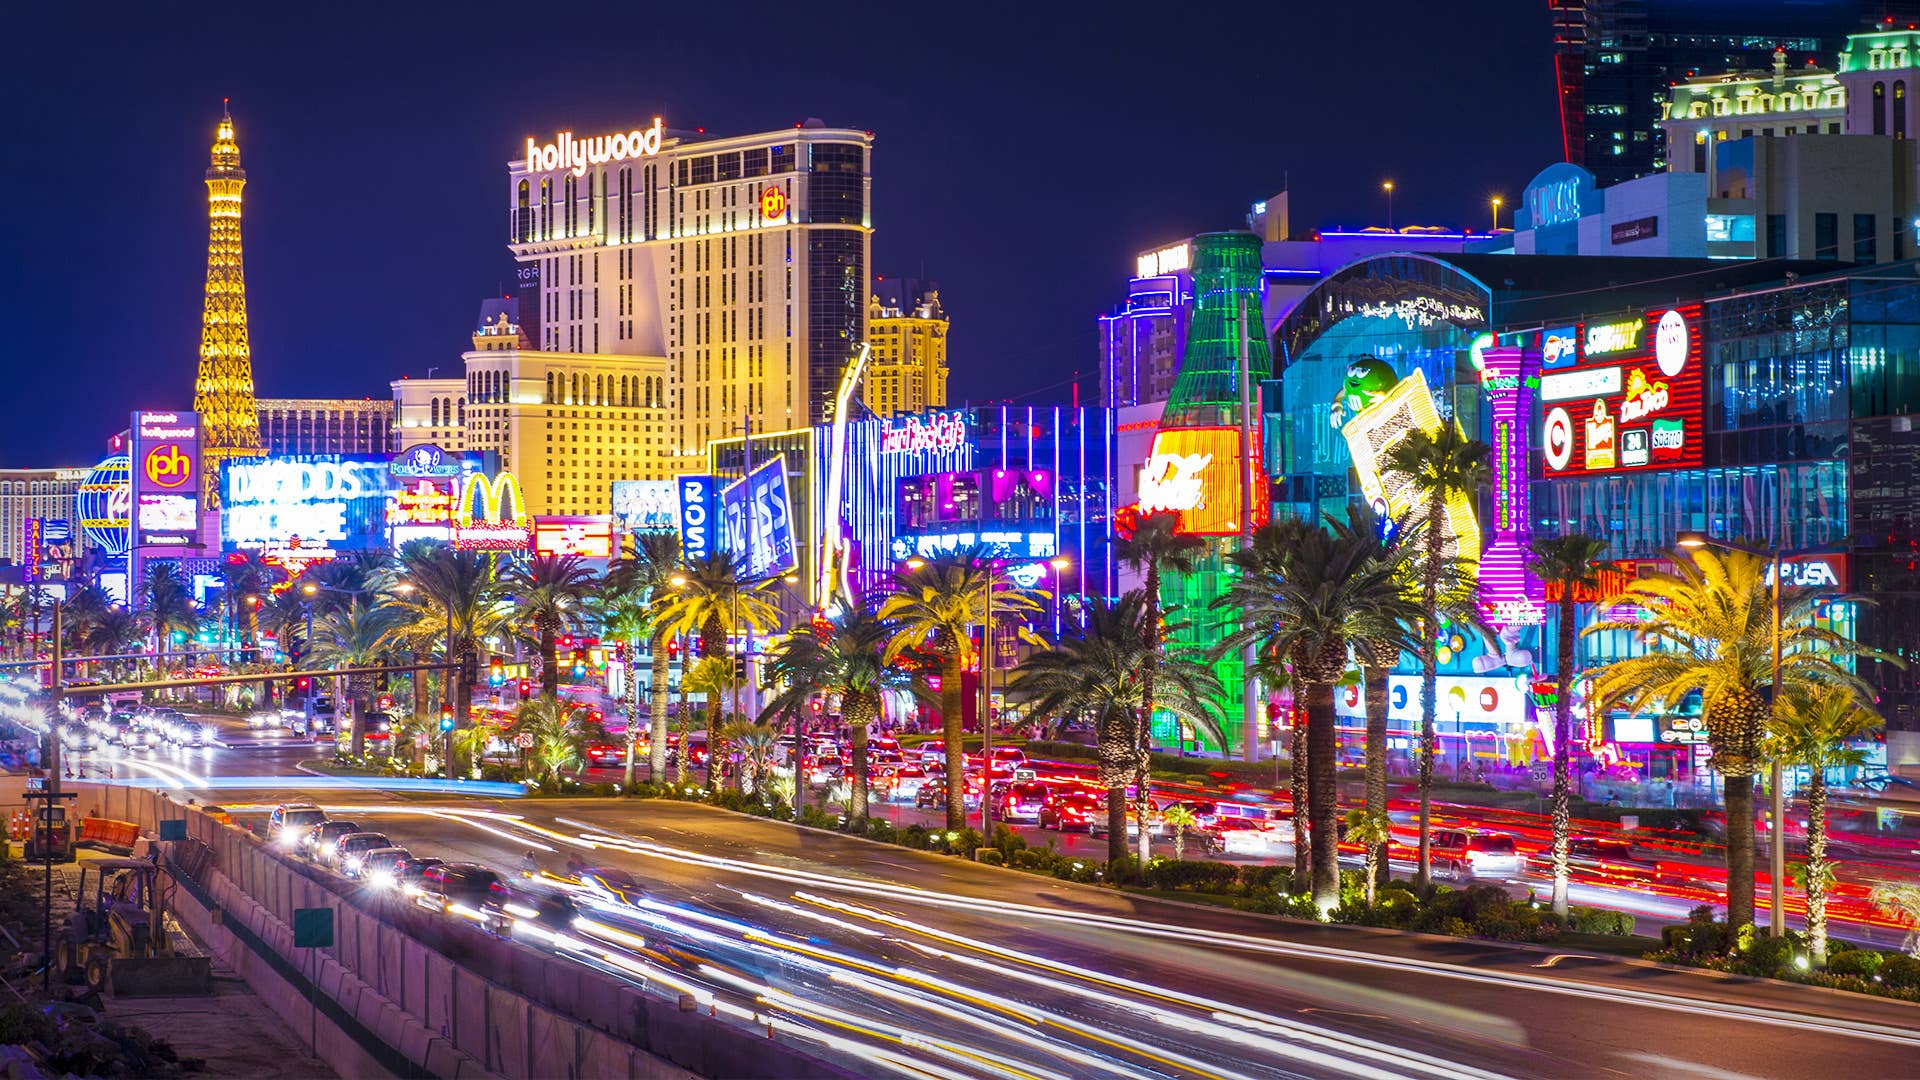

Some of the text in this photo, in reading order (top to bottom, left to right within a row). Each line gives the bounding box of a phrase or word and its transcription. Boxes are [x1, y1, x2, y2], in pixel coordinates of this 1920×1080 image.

[527, 117, 662, 177] hollywood
[1585, 318, 1643, 356] SUBWAY
[141, 427, 195, 439] hollywood
[151, 445, 190, 482] ph
[1707, 466, 1831, 551] RESORTS
[146, 535, 189, 544] Panason
[1534, 772, 1546, 780] 30
